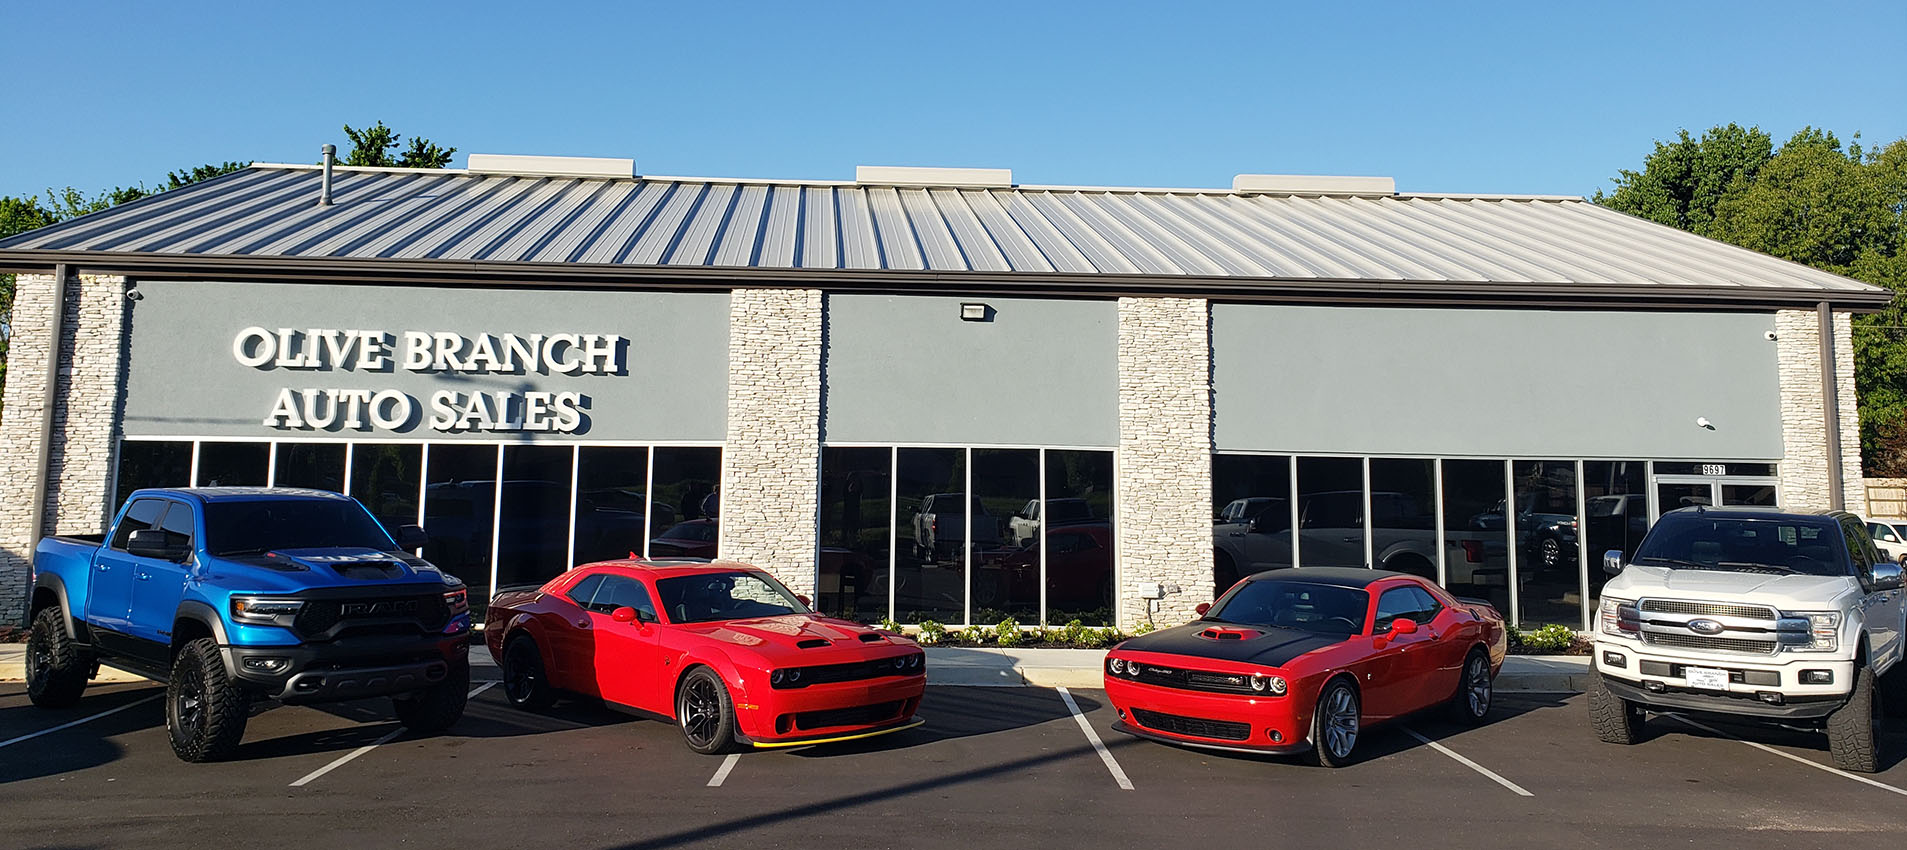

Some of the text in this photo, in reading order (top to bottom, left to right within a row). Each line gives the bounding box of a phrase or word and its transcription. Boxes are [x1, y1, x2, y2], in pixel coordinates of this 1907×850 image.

[233, 326, 619, 373] OLIVE BRANCH
[263, 388, 581, 432] AUTO SALES
[1704, 465, 1724, 475] 9697
[341, 600, 418, 616] RAM
